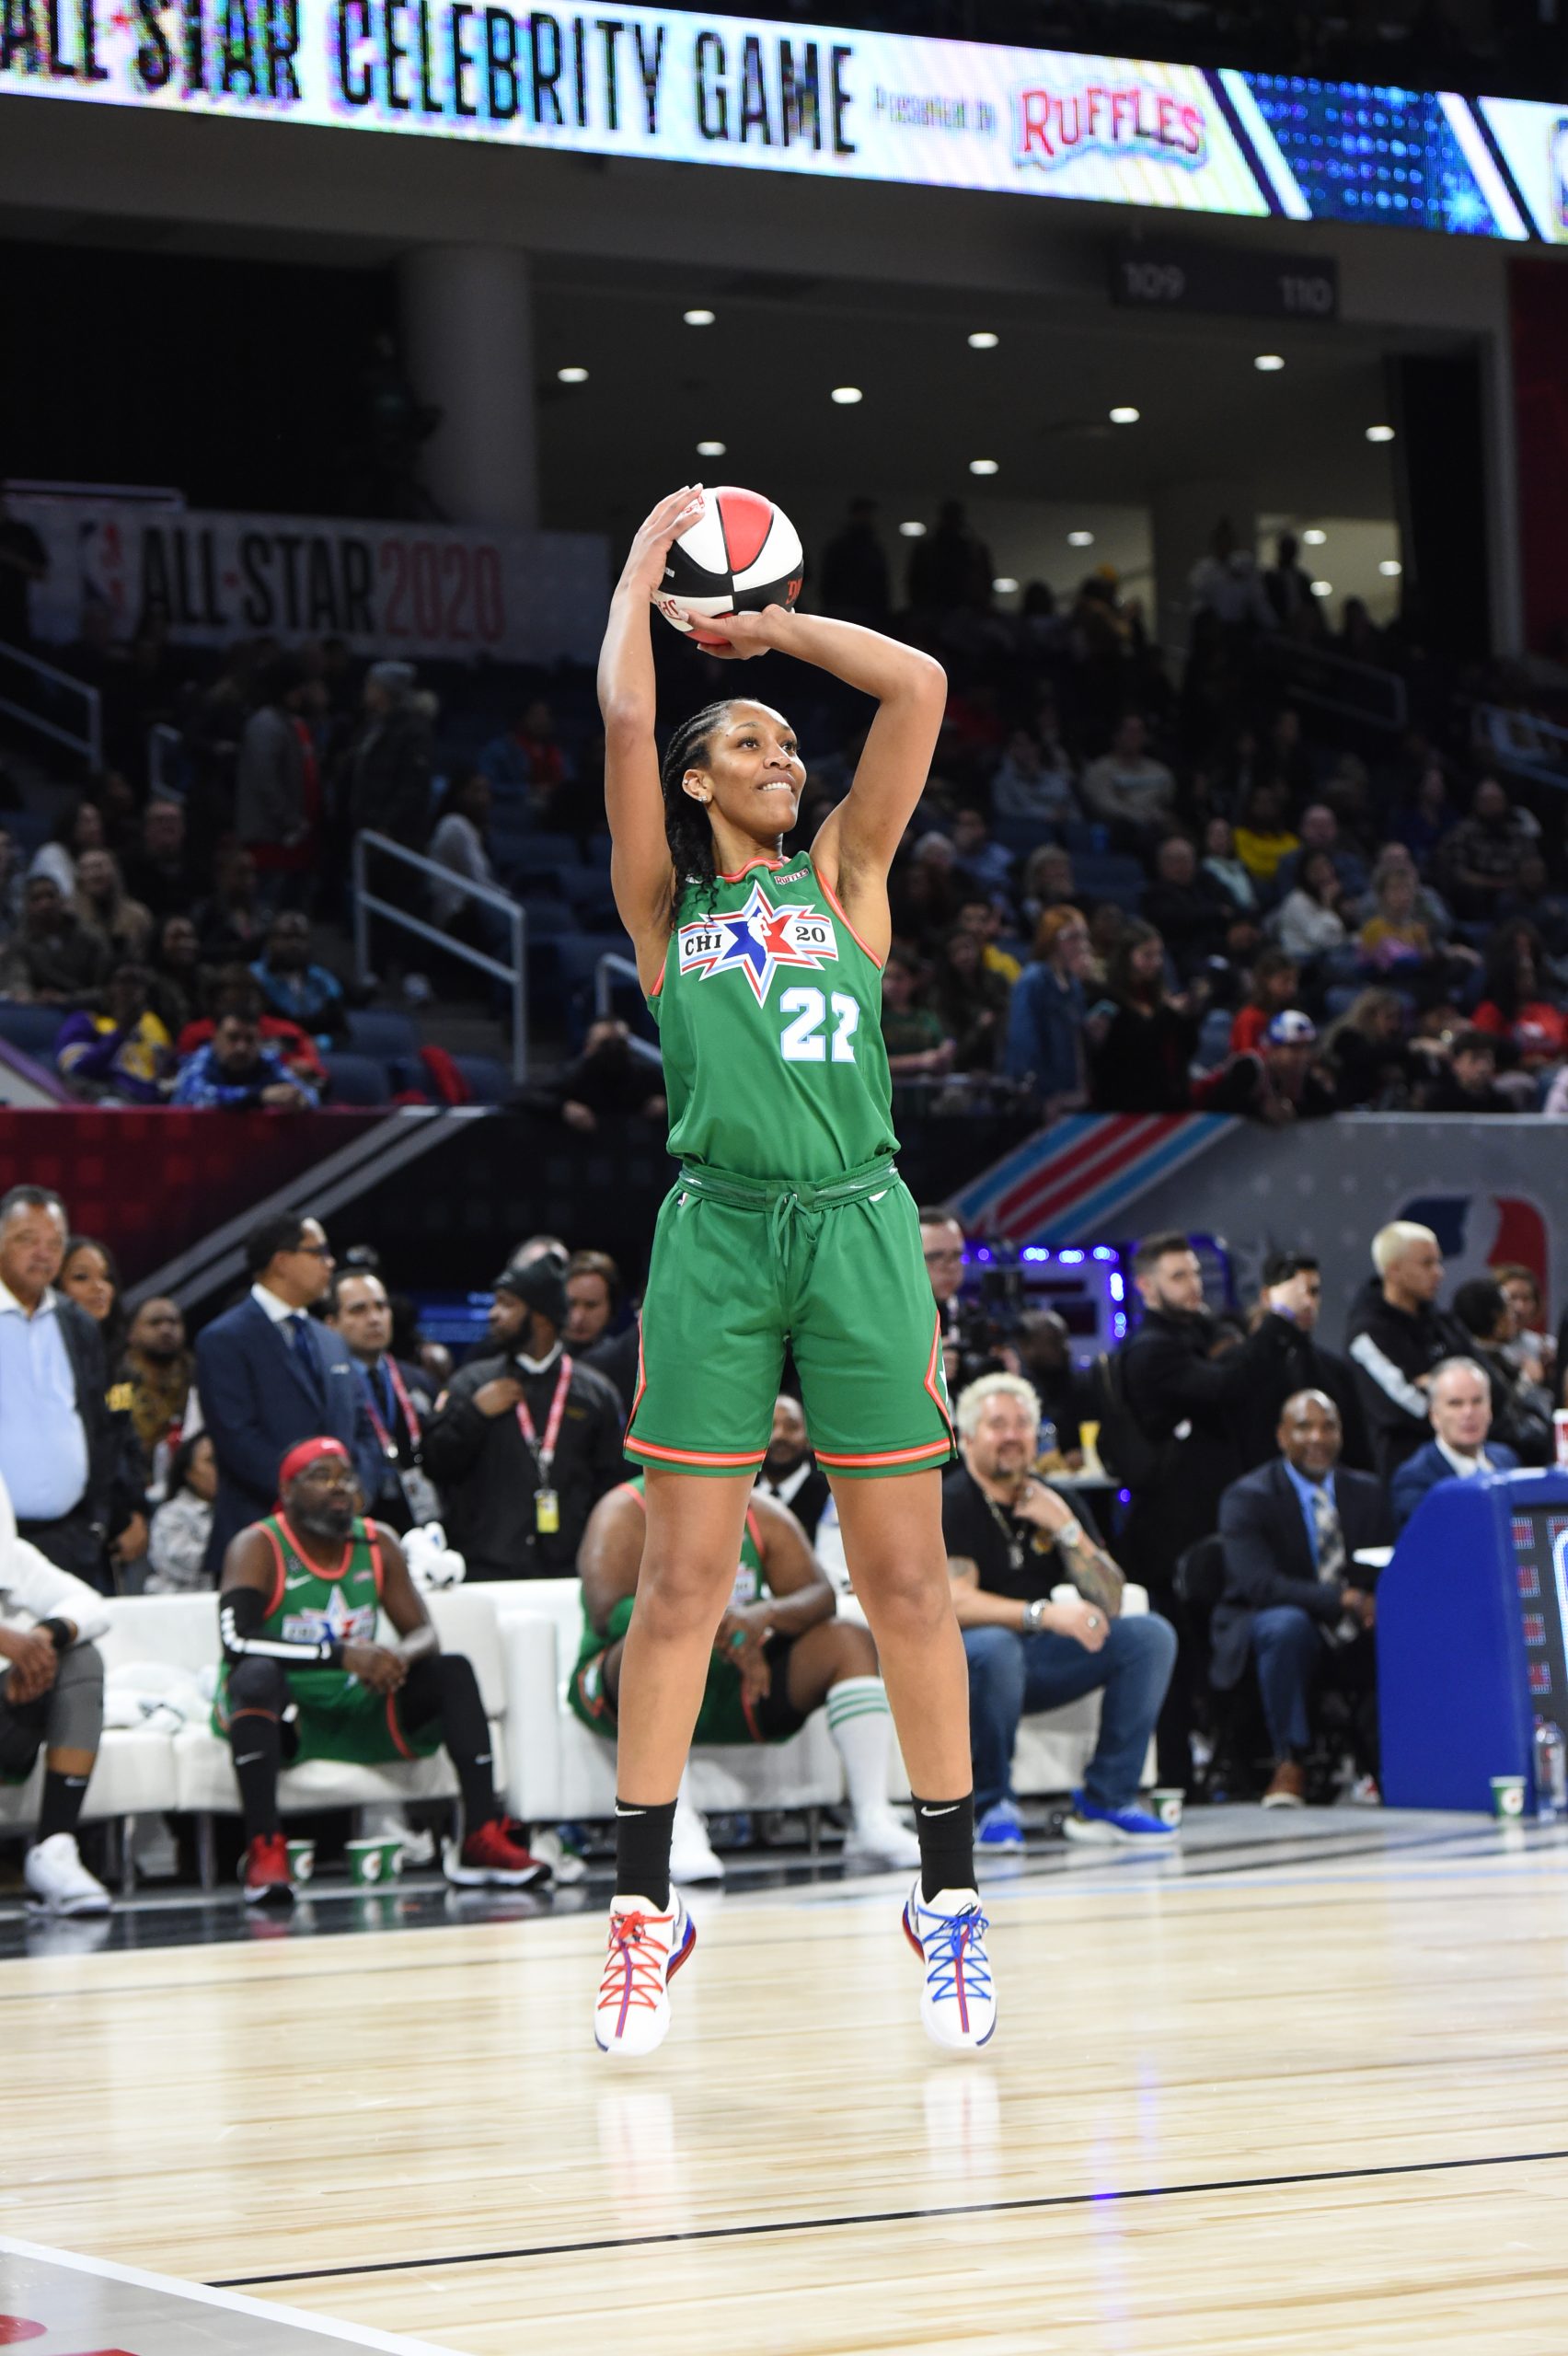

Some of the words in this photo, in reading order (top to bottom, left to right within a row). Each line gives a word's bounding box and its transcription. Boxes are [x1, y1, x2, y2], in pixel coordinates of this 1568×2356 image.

[338, 0, 664, 133] CELEBRITY
[696, 31, 857, 153] GAME
[1122, 261, 1185, 300] 109
[1279, 275, 1332, 313] 110
[380, 540, 506, 643] 2020
[685, 933, 721, 956] CHI
[795, 926, 826, 942] 20
[779, 987, 860, 1063] 22
